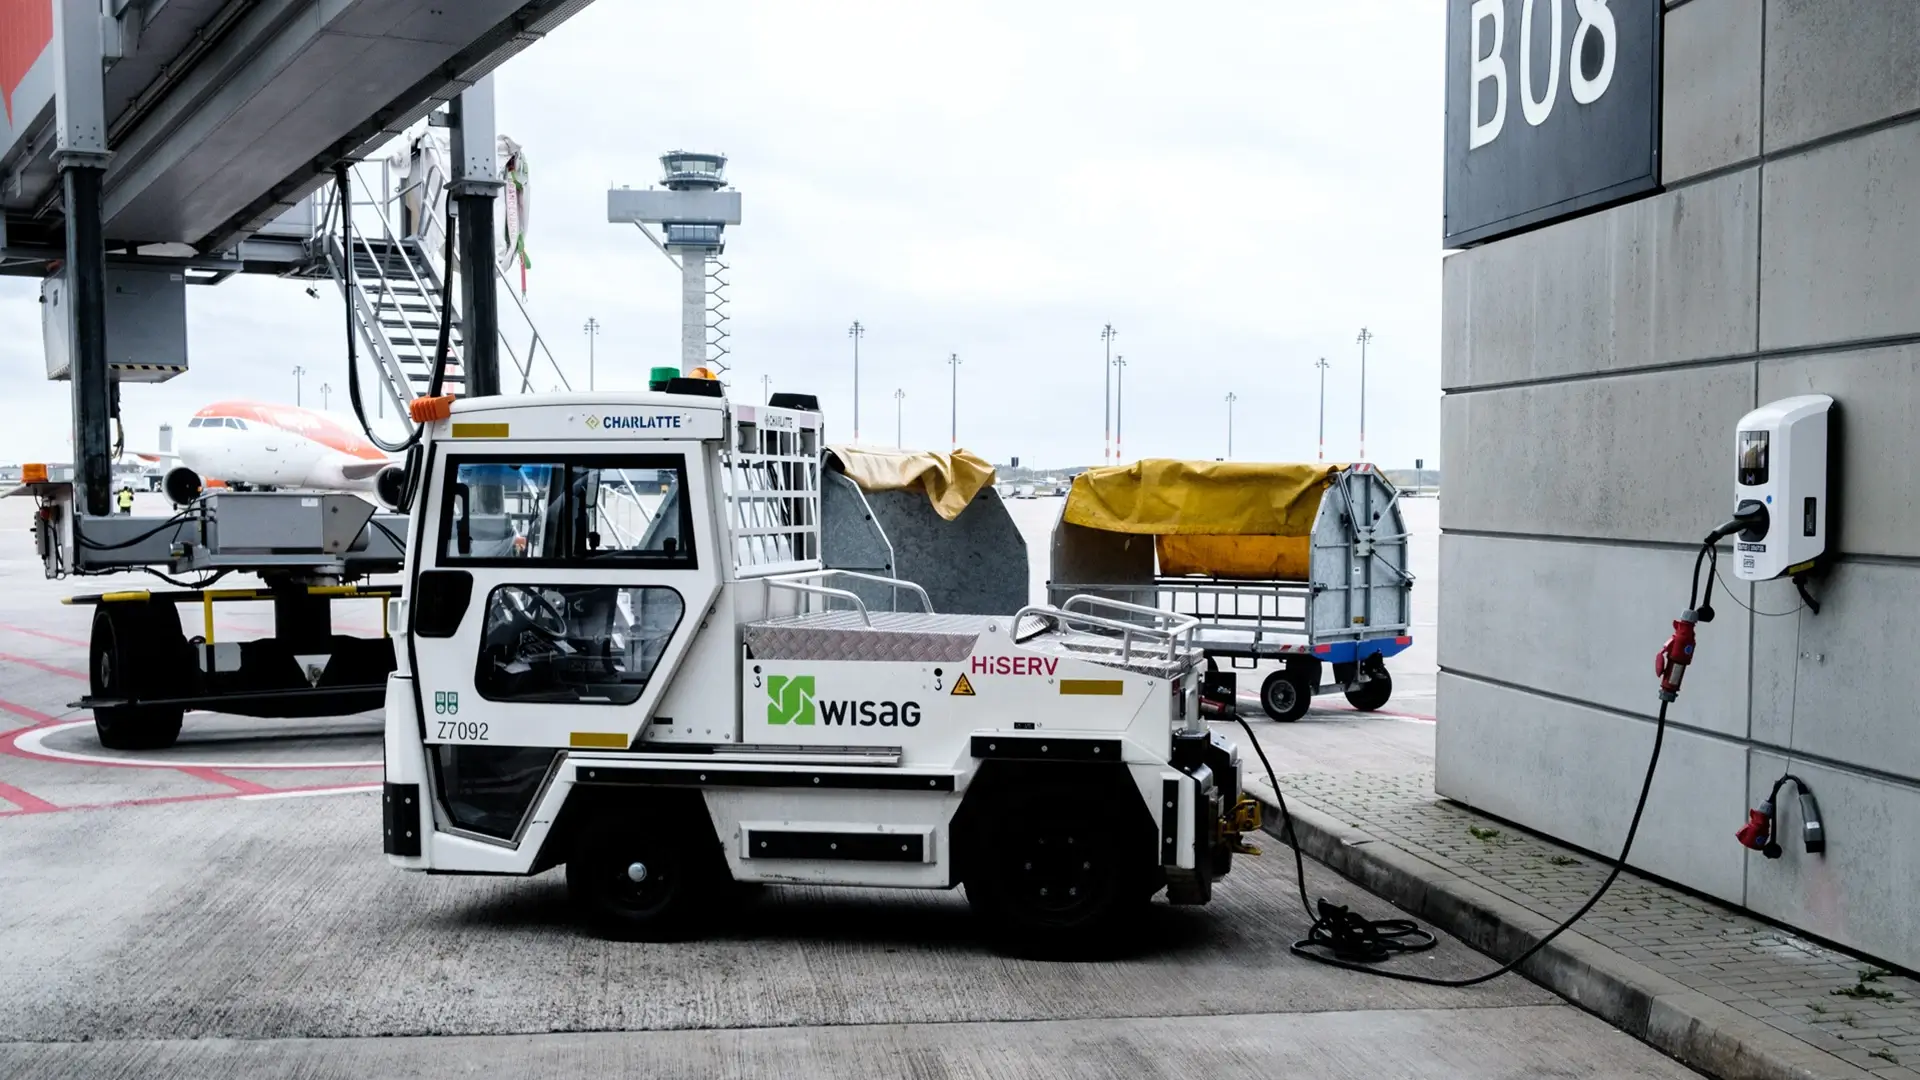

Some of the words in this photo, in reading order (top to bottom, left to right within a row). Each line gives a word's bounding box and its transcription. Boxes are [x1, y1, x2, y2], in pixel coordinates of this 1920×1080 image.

[1469, 0, 1617, 151] B08
[603, 416, 681, 429] CHARLATTE
[972, 656, 1059, 676] HiSERV
[437, 721, 489, 740] Z7092
